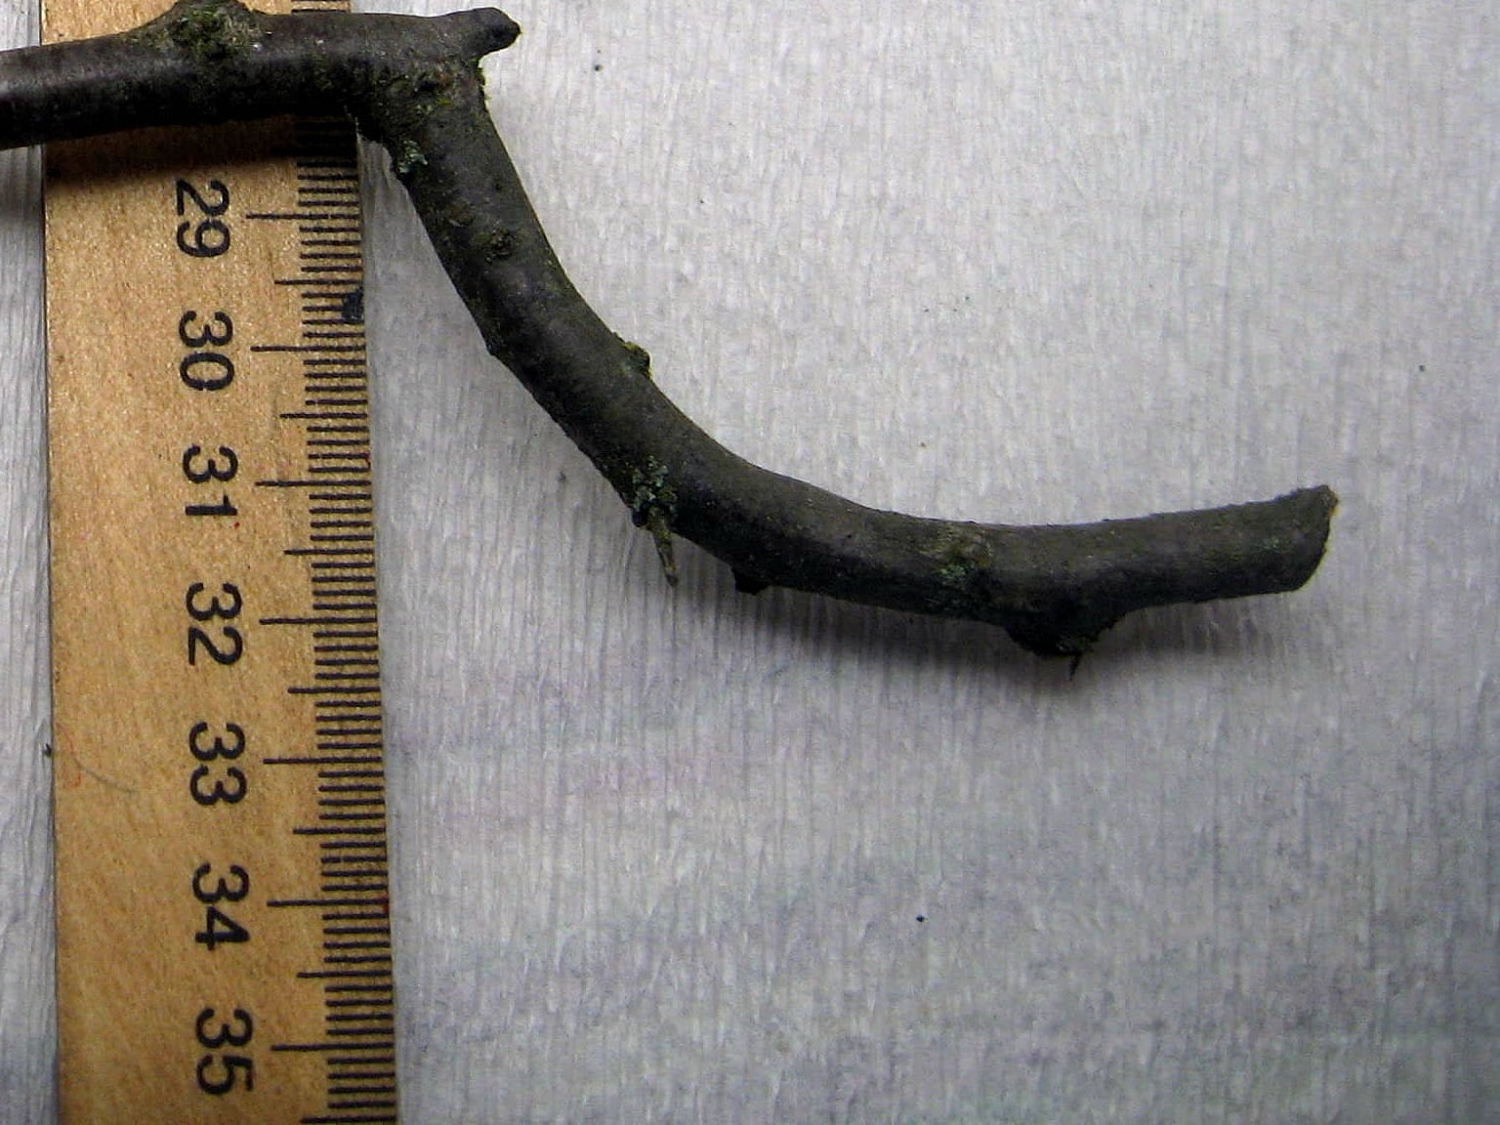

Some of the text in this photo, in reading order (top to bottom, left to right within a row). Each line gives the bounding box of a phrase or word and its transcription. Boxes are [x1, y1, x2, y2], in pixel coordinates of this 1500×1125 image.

[176, 179, 231, 259] 29
[178, 310, 236, 392] 30
[182, 445, 239, 518] 31
[185, 582, 244, 666] 32
[188, 721, 248, 807] 33
[192, 863, 251, 952] 34
[195, 1007, 254, 1098] 35
